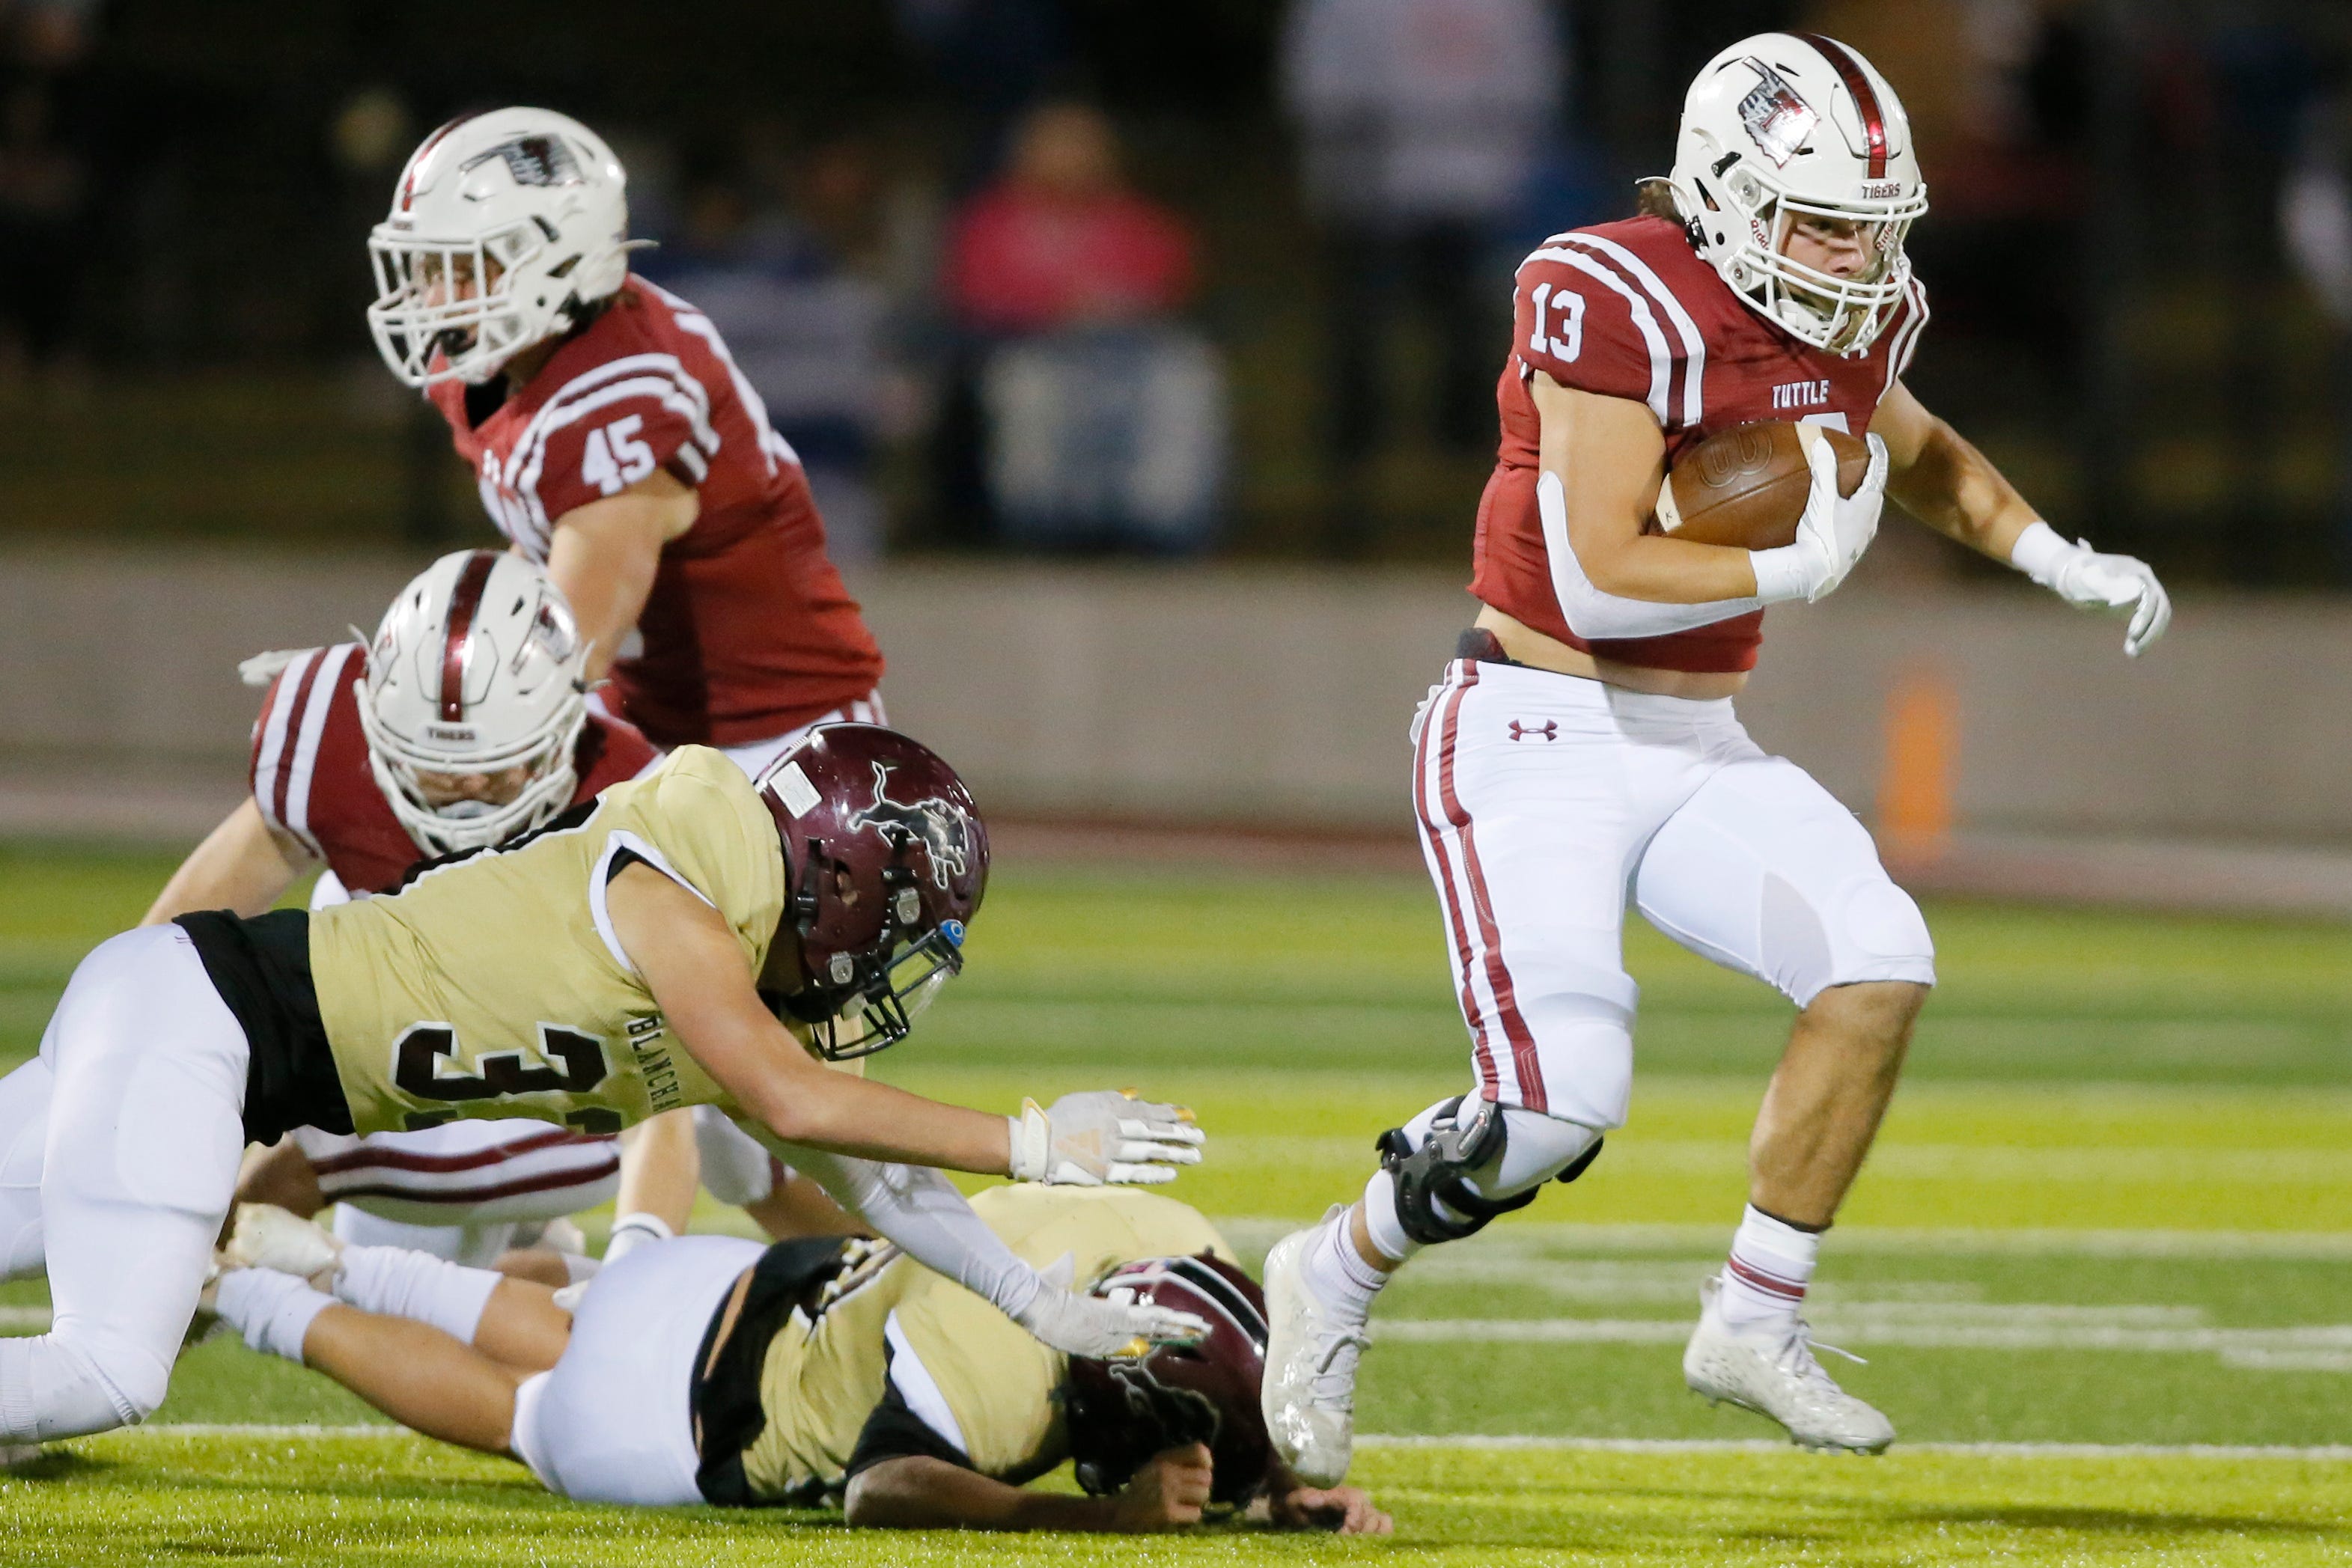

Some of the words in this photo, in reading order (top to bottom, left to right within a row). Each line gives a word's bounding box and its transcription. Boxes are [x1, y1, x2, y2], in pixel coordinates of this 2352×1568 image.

[1862, 183, 1901, 199] TIGERS
[1750, 219, 1769, 251] Ridd
[1529, 281, 1586, 364] 13
[1772, 379, 1830, 409] TUTTLE
[582, 412, 656, 497] 45
